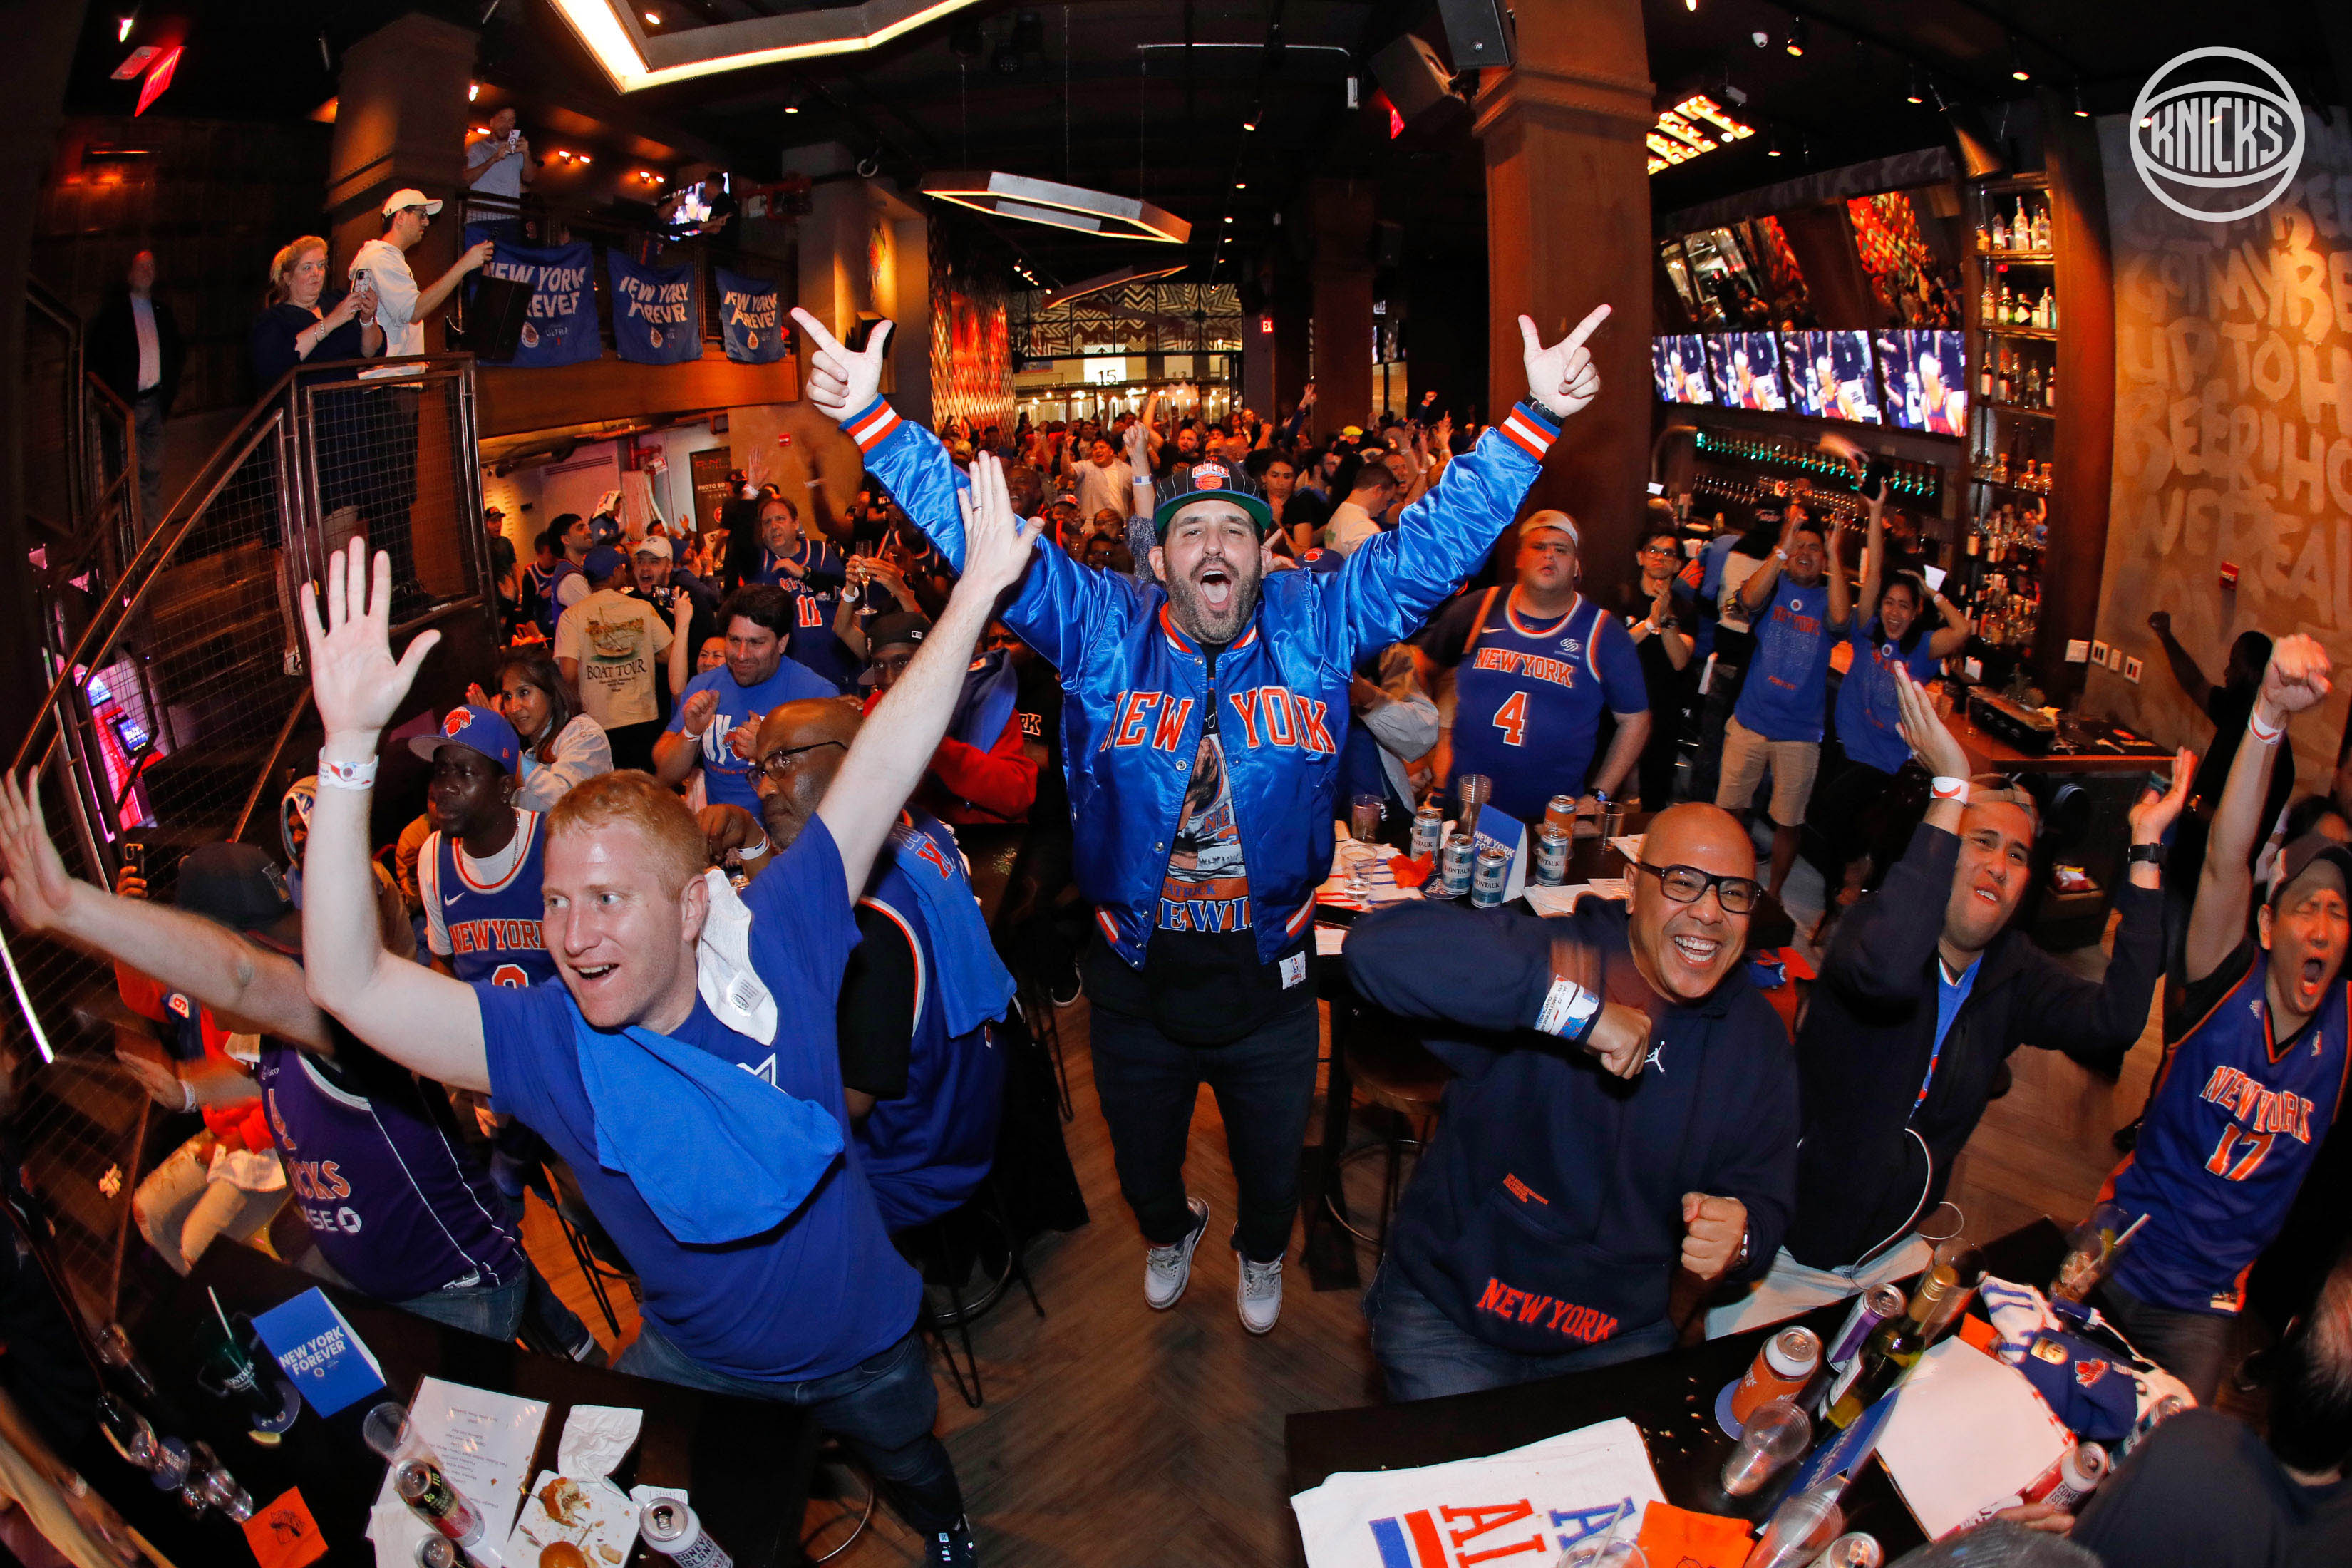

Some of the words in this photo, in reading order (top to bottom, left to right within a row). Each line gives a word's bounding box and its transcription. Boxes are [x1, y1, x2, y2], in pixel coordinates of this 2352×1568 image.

[1098, 369, 1117, 383] 15
[796, 594, 822, 628] 11
[587, 665, 613, 680] BOAT
[616, 659, 647, 676] TOUR
[1473, 648, 1520, 674] NEW
[1522, 654, 1574, 688] YORK
[1492, 690, 1527, 747] 4
[1412, 840, 1433, 848] ONTAUK
[1474, 830, 1493, 846] NEW
[448, 919, 490, 955] NEW
[1542, 996, 1552, 1014] CLINTON
[2199, 1065, 2266, 1122] NEW
[2252, 1090, 2315, 1145] YORK
[2204, 1122, 2276, 1182] 17
[1476, 1276, 1553, 1324] NEW
[1547, 1299, 1618, 1343] YORK
[279, 1344, 309, 1369] NEW
[307, 1325, 345, 1351] YORK
[291, 1339, 347, 1376] FOREVER
[674, 1536, 706, 1562] CONEY
